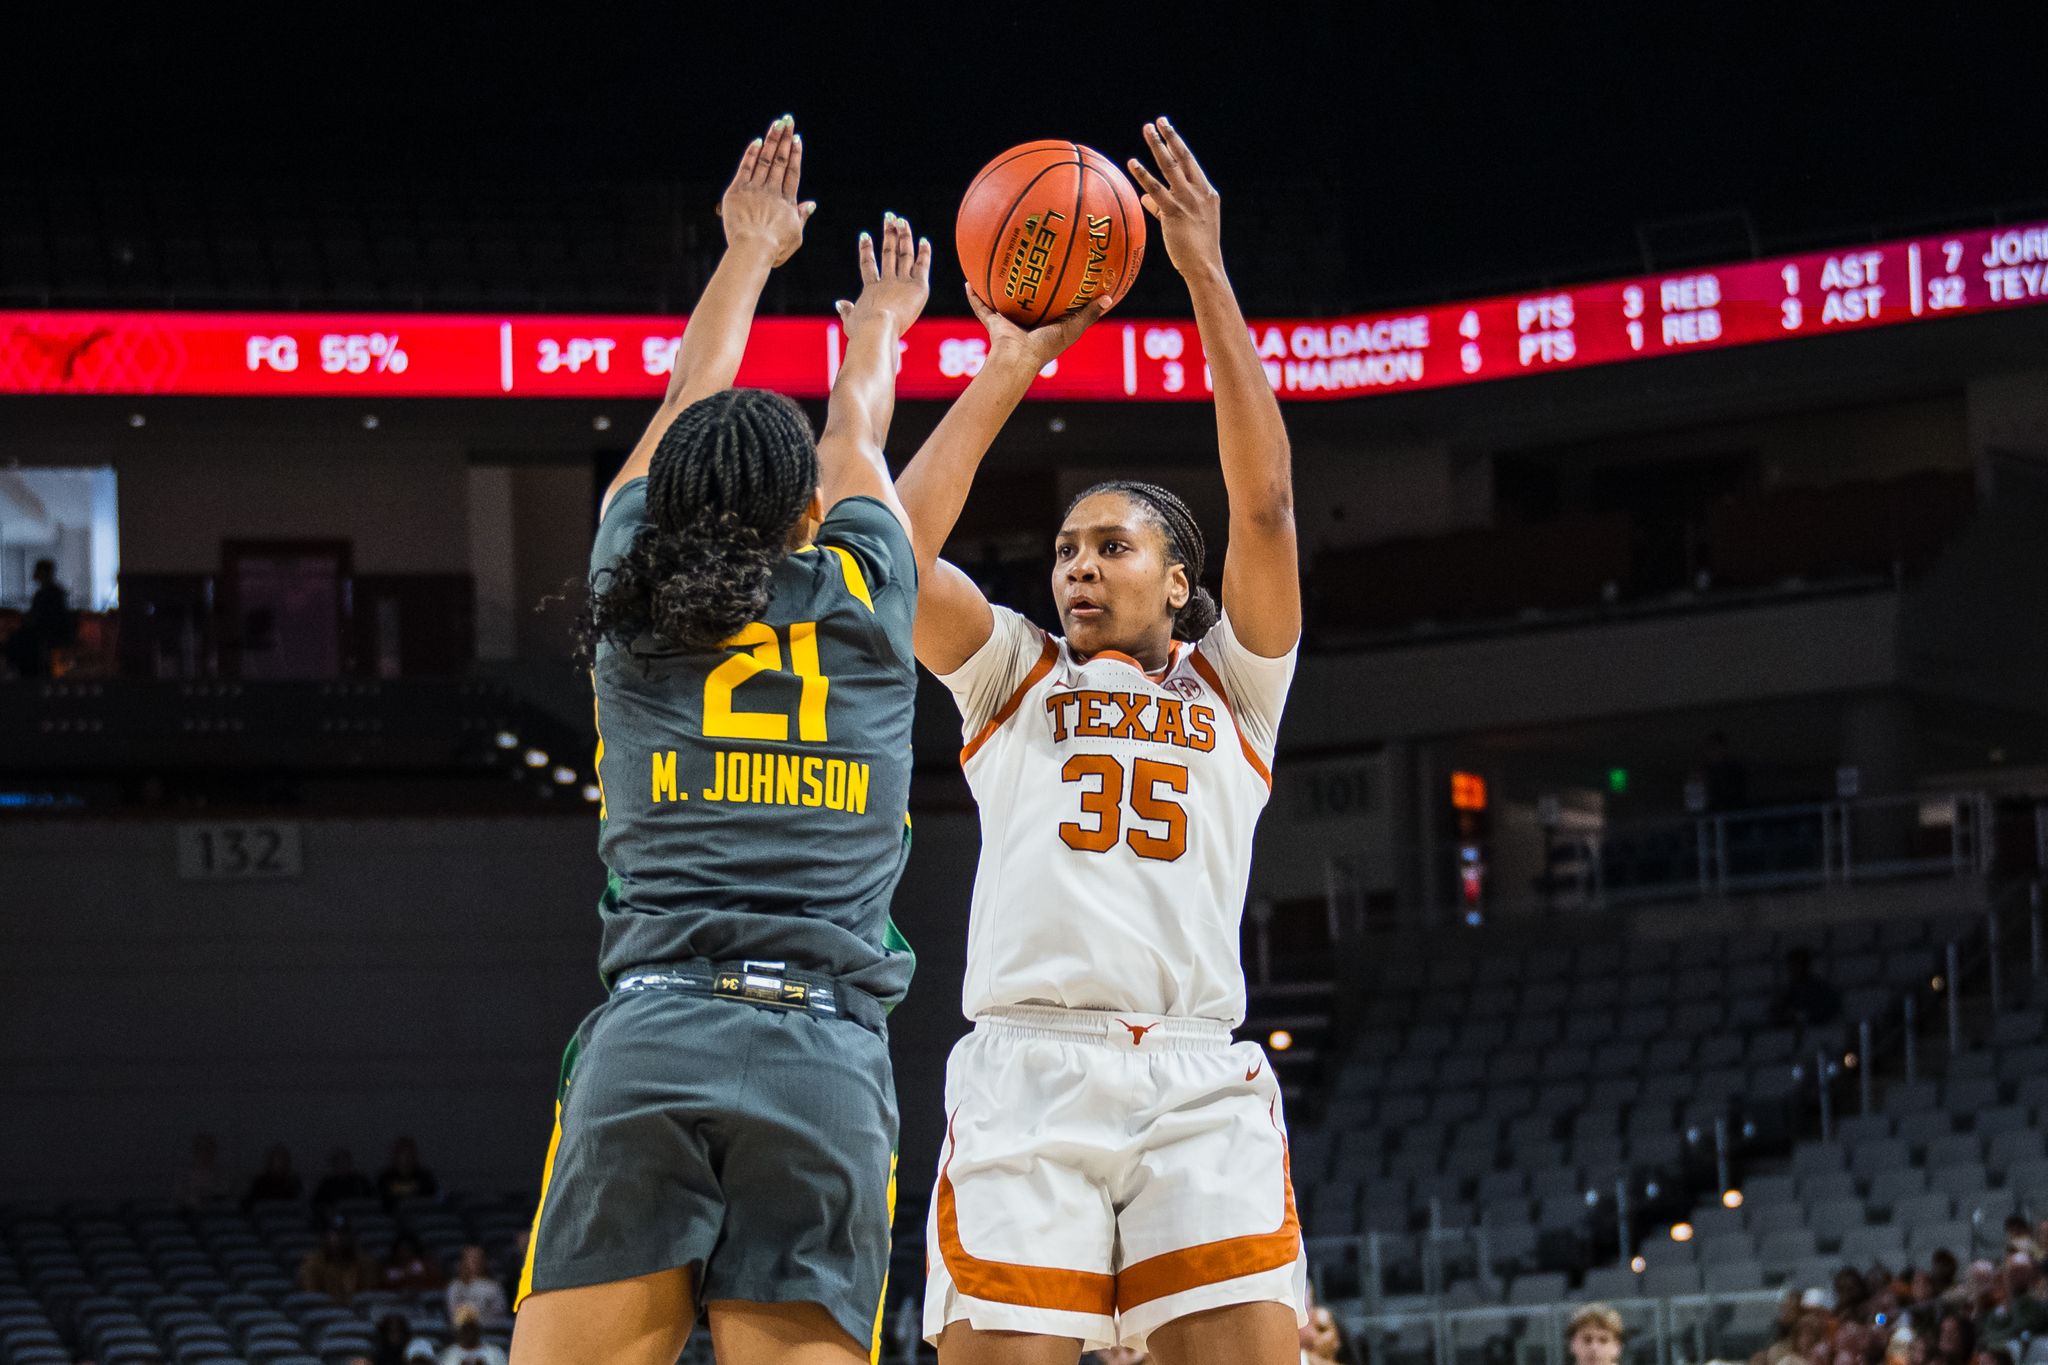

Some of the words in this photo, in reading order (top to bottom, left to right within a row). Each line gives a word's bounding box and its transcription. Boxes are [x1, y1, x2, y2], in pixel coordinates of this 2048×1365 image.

[1017, 209, 1066, 311] LEGACY
[1065, 214, 1112, 312] SPALDIN
[1942, 240, 1964, 273] 7
[1163, 361, 1184, 392] 3
[1285, 351, 1424, 391] HARMON
[1519, 329, 1576, 366] PTS
[1626, 320, 1644, 351] 1
[1662, 308, 1722, 346] REB
[1781, 296, 1802, 329] 3
[1822, 285, 1886, 324] AST
[1291, 315, 1429, 359] OLDACRE
[1459, 310, 1480, 339] 4
[1518, 295, 1574, 333] PTS
[1623, 285, 1644, 318] 3
[1661, 273, 1721, 312] REB
[1782, 263, 1799, 295] 1
[1820, 251, 1883, 291] AST
[247, 335, 298, 372] FG
[320, 333, 408, 374] 55%
[537, 338, 616, 373] 3-PT
[703, 622, 829, 742] 21
[1046, 690, 1216, 753] TEXAS
[652, 751, 689, 803] M.
[703, 752, 869, 814] JOHNSON
[1059, 754, 1188, 862] 35
[199, 828, 285, 872] 132
